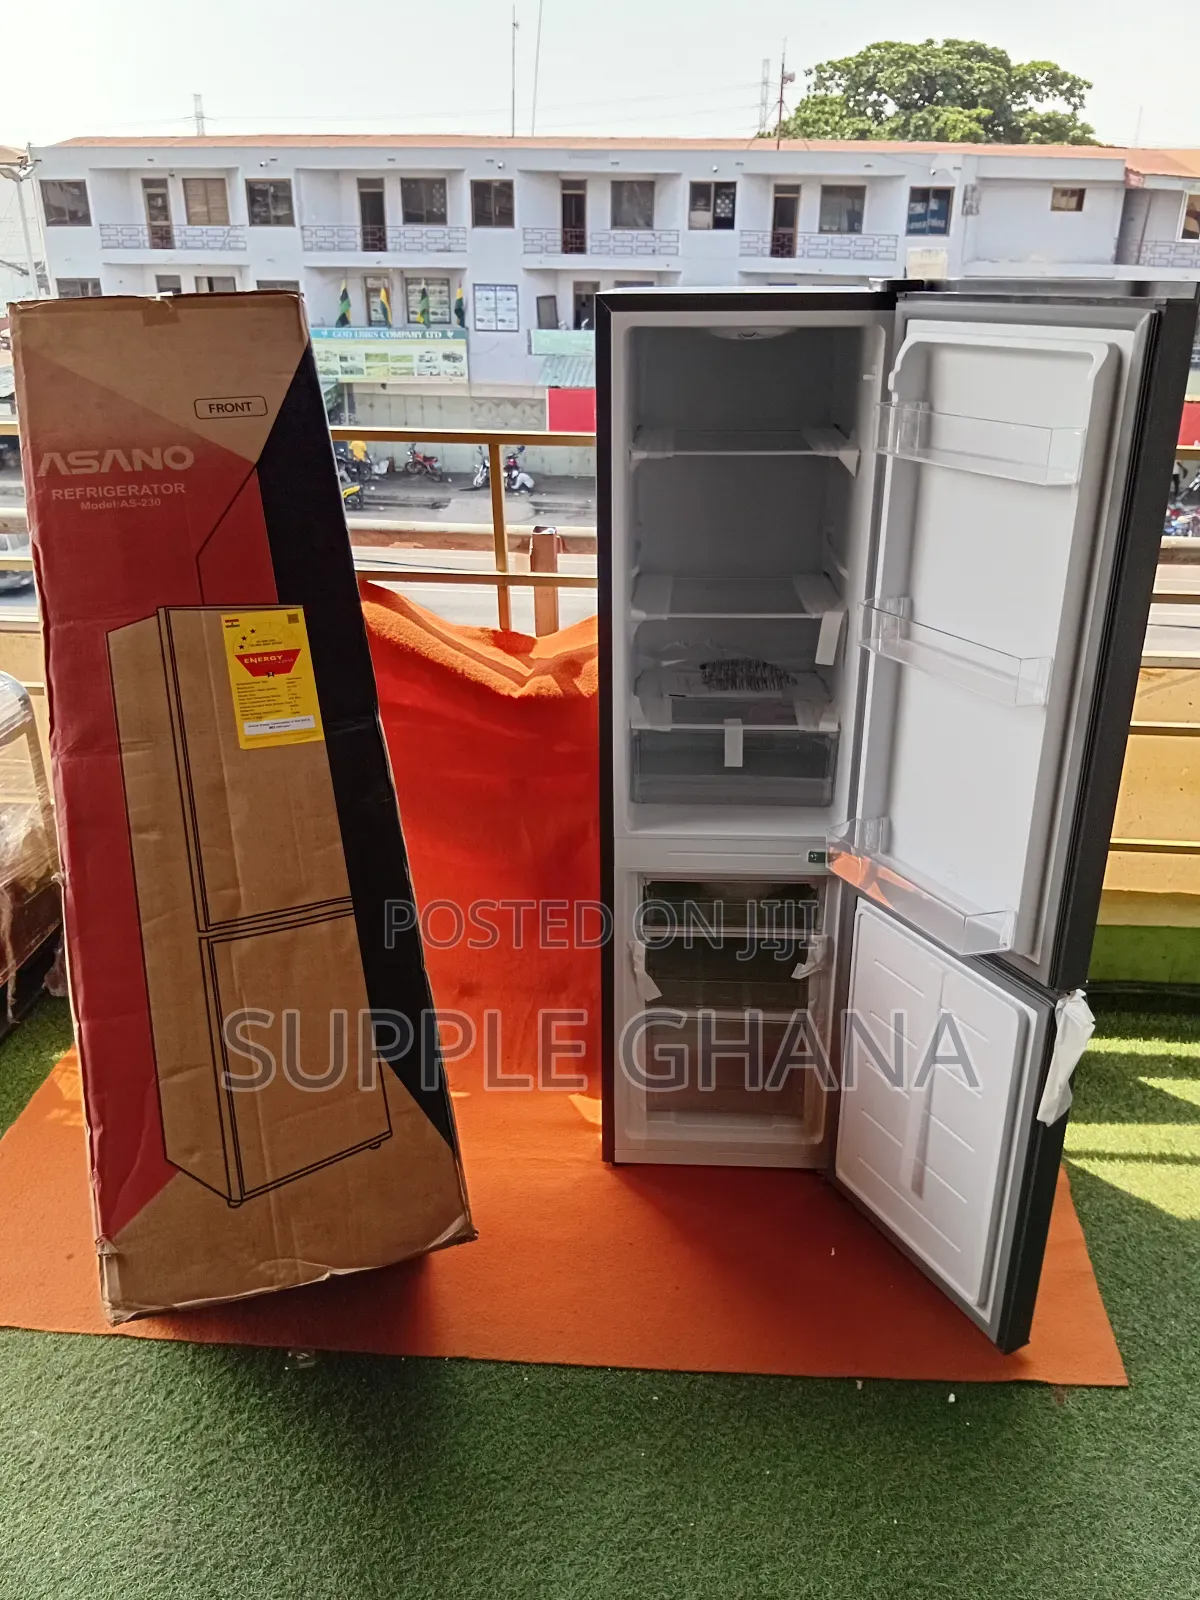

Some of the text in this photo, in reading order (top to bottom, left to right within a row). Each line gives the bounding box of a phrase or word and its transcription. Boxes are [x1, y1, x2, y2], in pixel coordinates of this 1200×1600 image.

[380, 330, 423, 339] COMPANY
[425, 330, 442, 339] LTD
[208, 402, 252, 414] FRONT
[36, 445, 195, 477] ASANO
[51, 482, 186, 500] REFRIGERATOR
[243, 654, 283, 664] ENERGY
